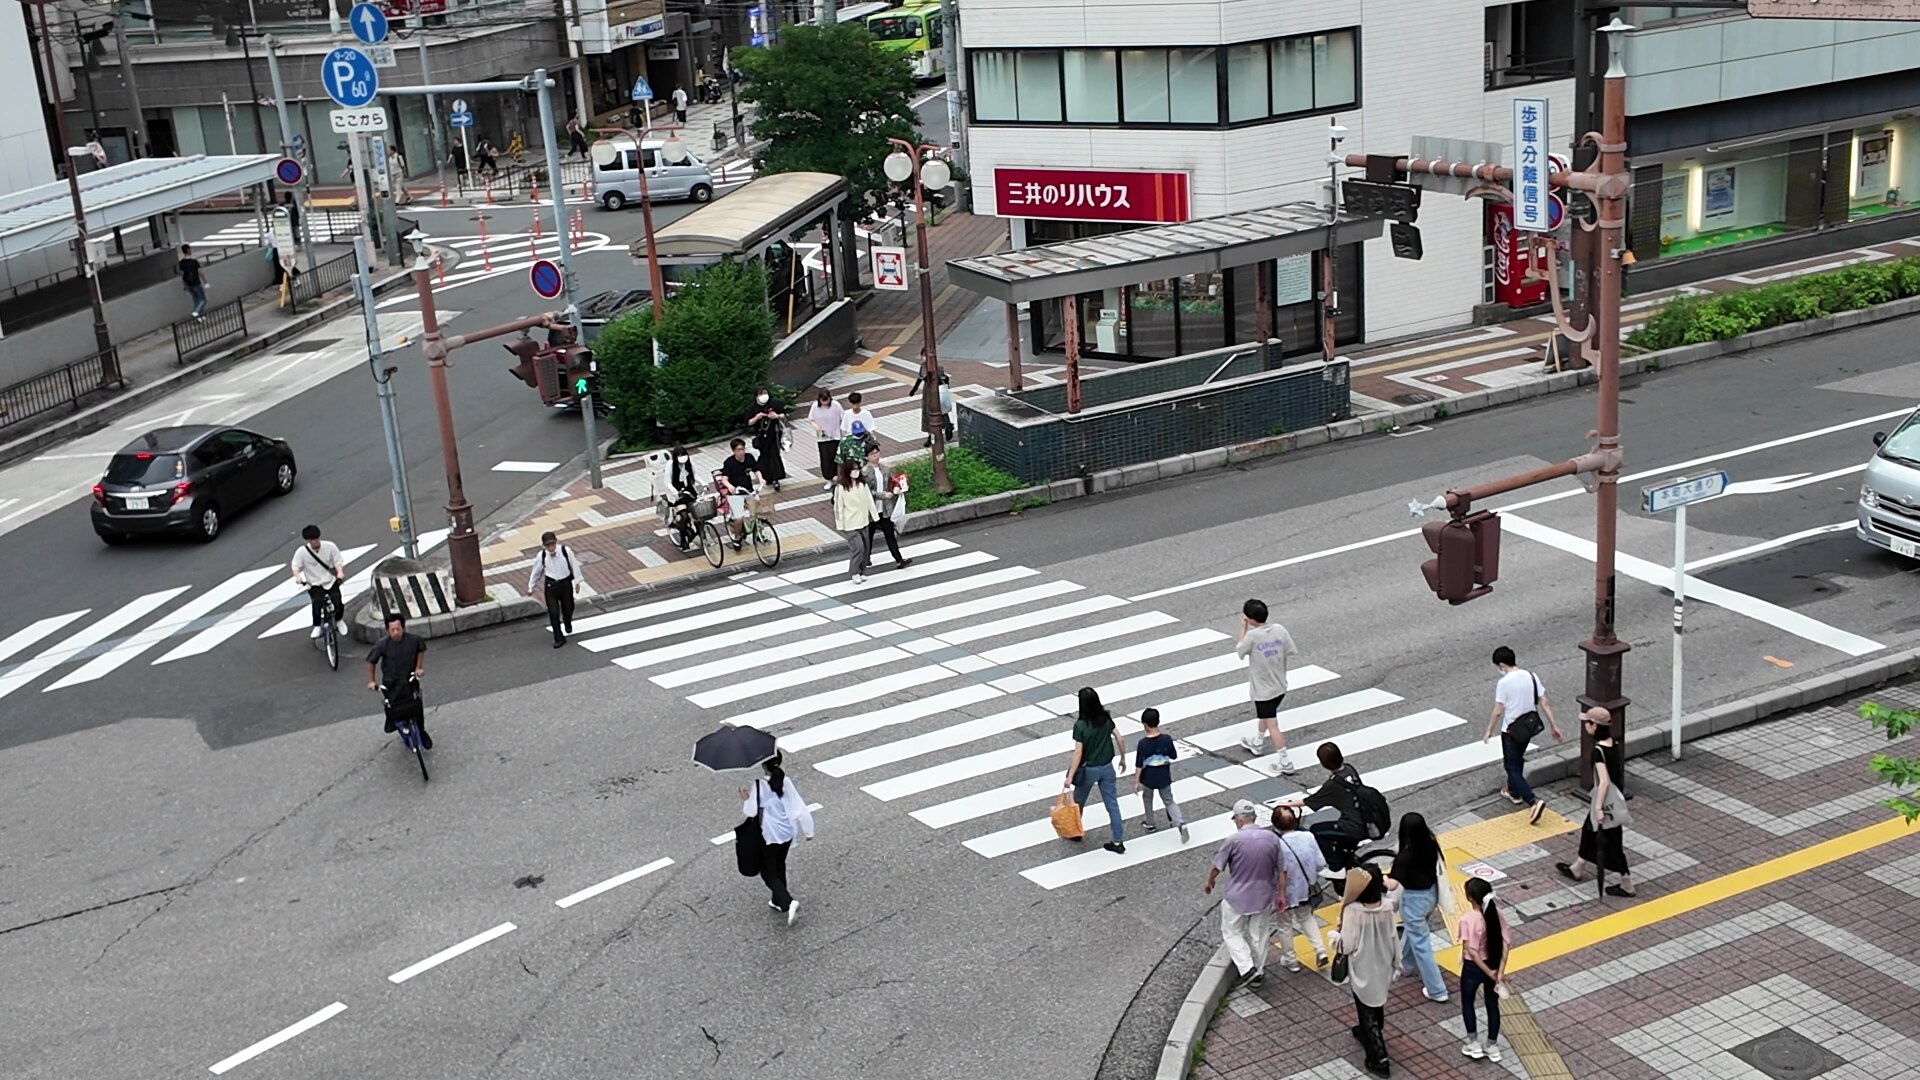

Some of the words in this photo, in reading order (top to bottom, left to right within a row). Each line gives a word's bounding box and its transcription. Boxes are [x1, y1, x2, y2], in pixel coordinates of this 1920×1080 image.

[332, 61, 355, 98] P
[352, 80, 368, 97] 60
[334, 113, 384, 127] ここから
[1521, 105, 1539, 223] 歩車分離信号
[1008, 182, 1130, 208] 三井のリハウス
[1661, 478, 1714, 499] 本町大通り
